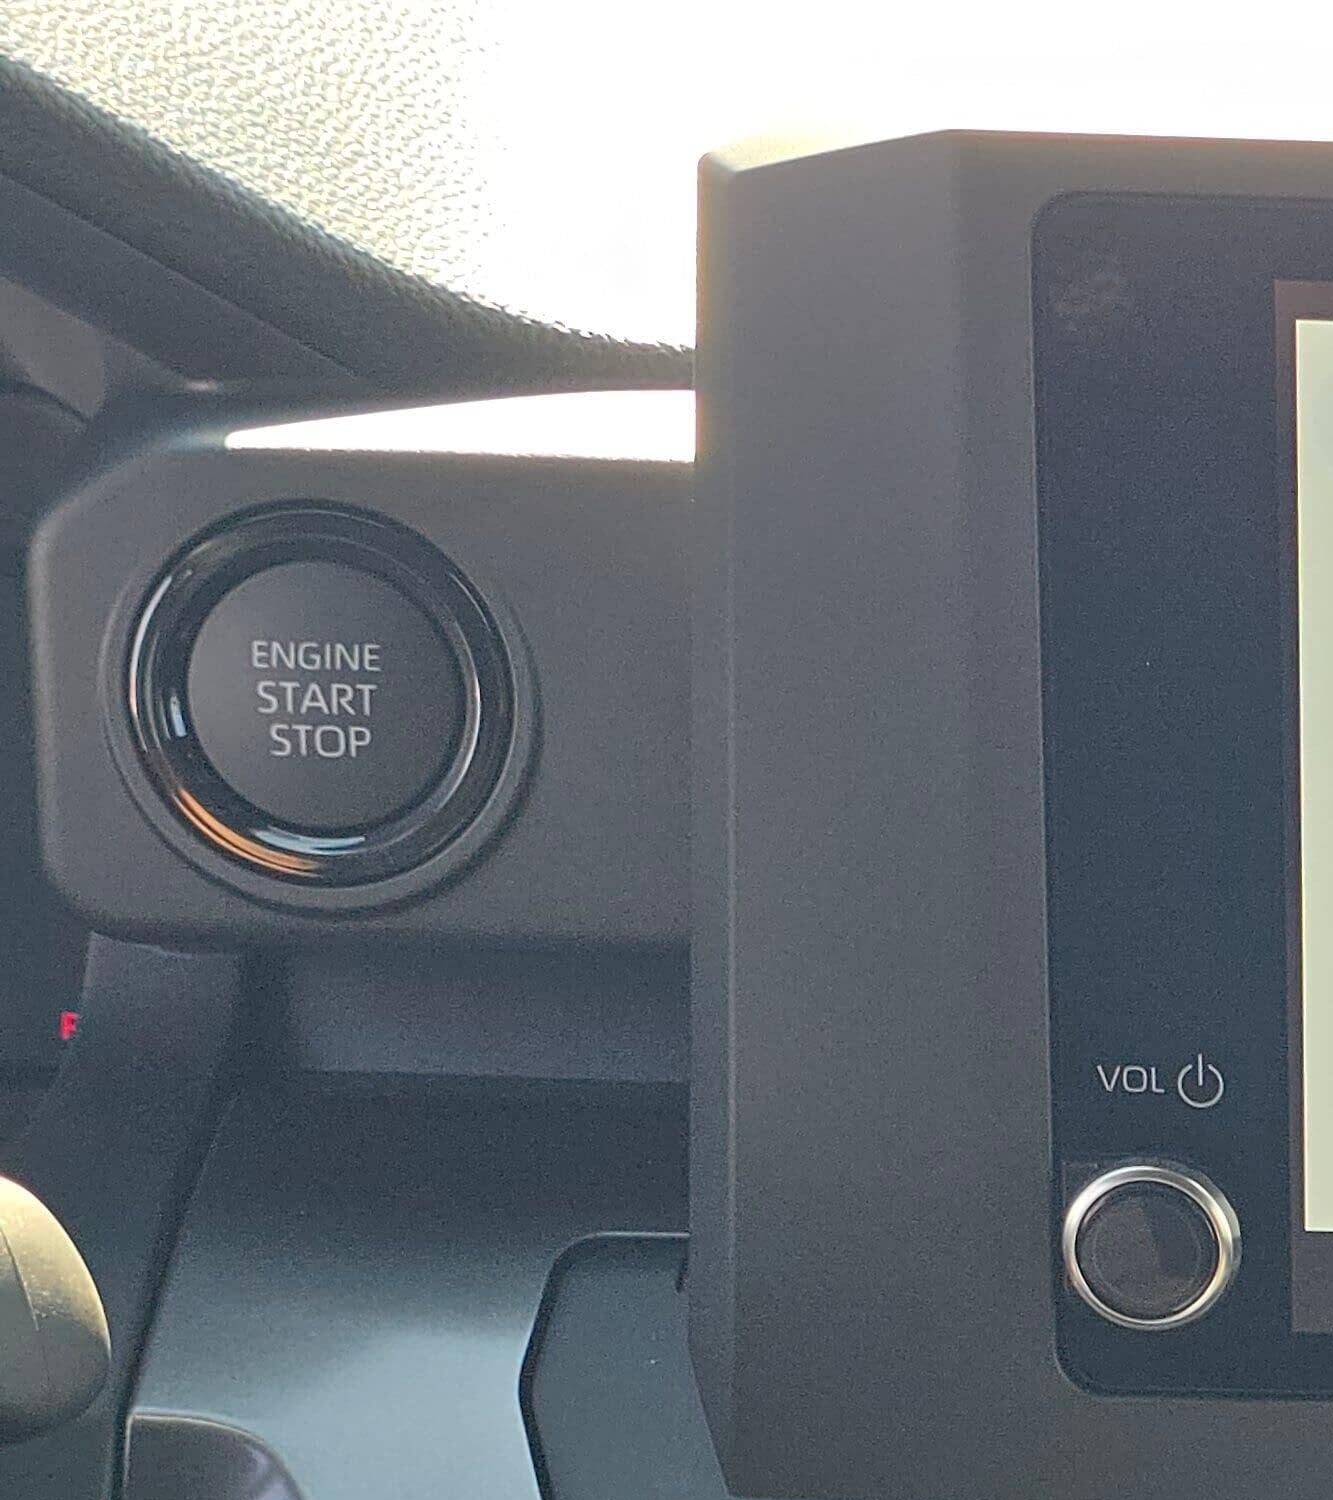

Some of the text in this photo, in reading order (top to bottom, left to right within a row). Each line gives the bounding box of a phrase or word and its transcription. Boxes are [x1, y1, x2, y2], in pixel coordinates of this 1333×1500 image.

[250, 640, 381, 672] ENGINE
[256, 681, 377, 716] START
[269, 724, 373, 758] STOP
[1097, 1064, 1165, 1094] VOL
